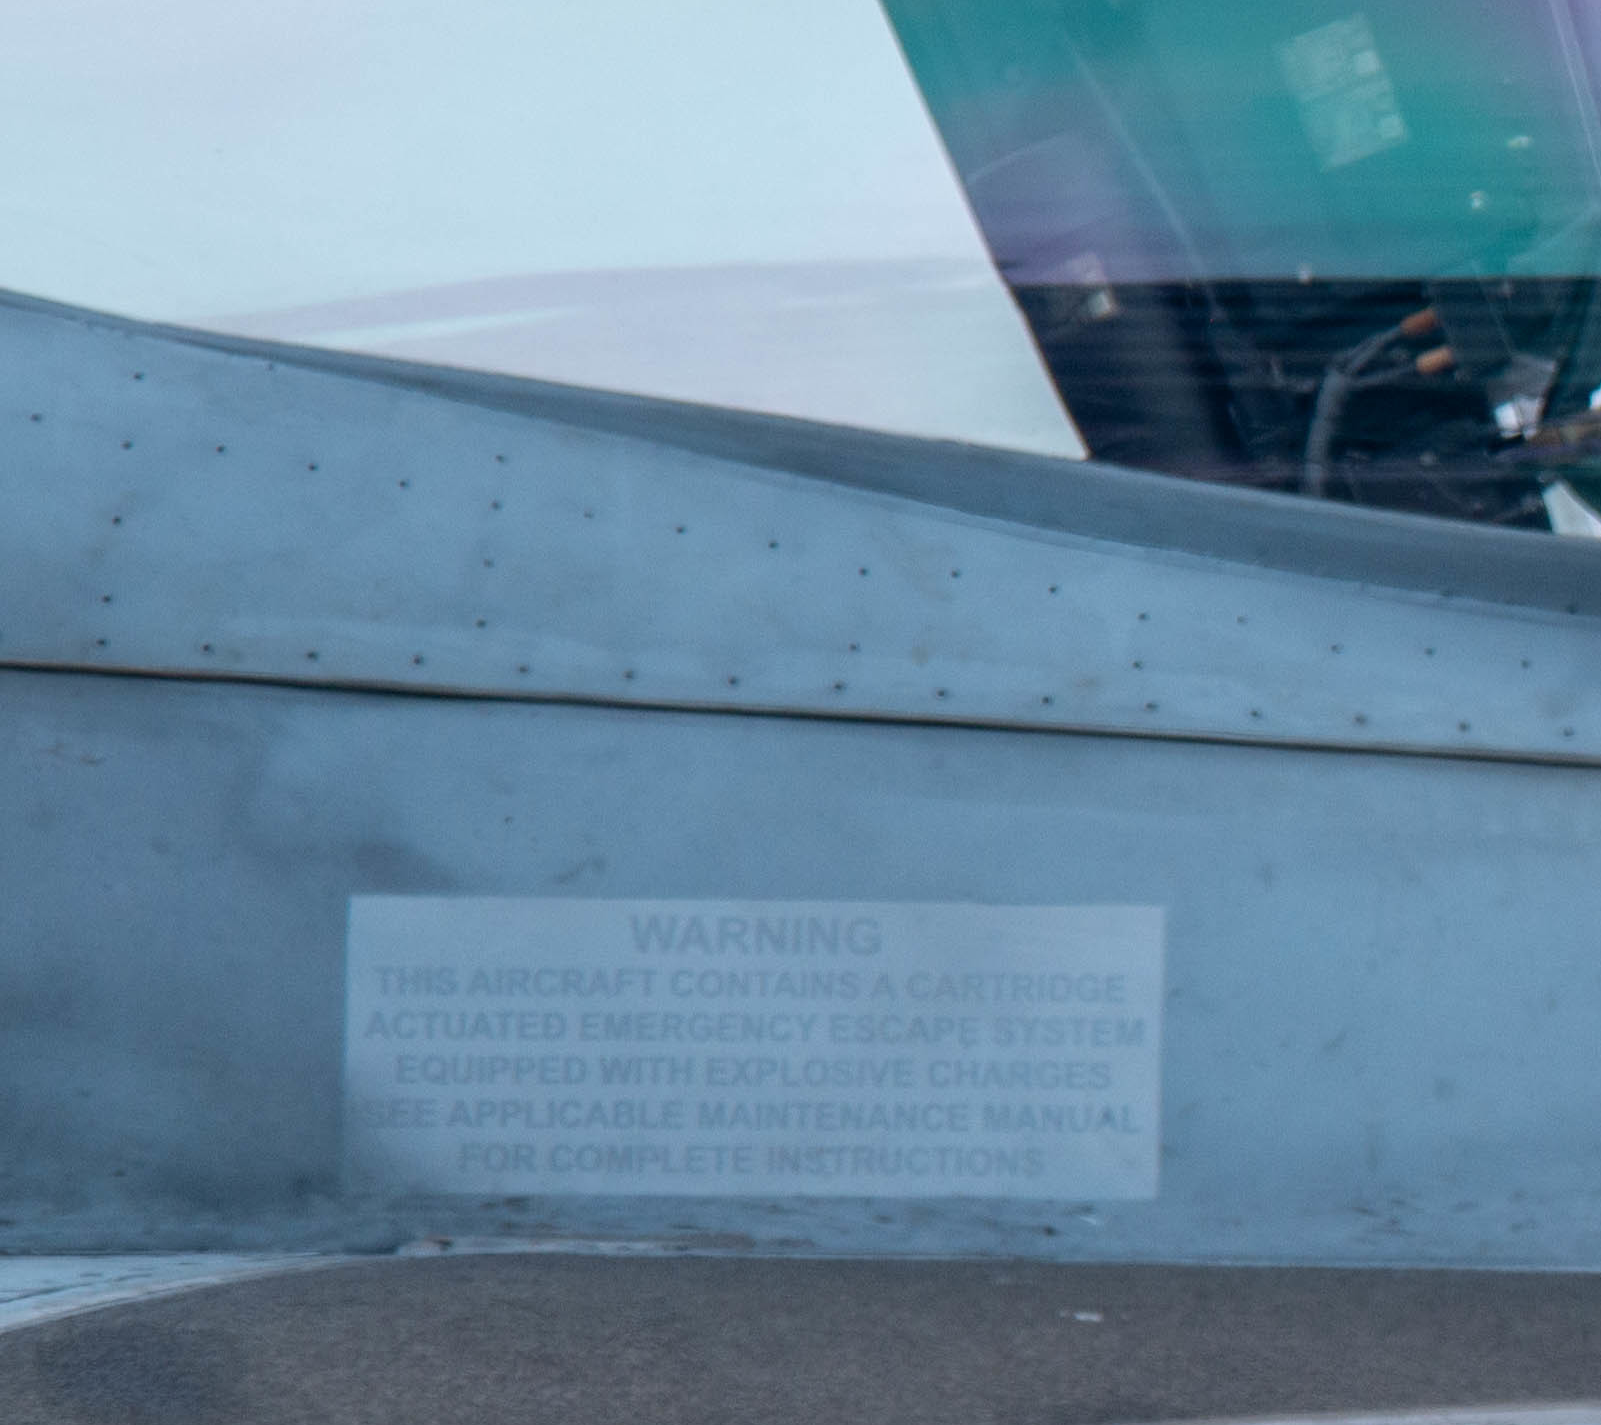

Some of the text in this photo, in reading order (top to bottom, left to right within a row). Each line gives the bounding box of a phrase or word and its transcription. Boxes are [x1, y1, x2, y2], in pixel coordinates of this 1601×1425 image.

[629, 914, 882, 957] WARNING
[374, 966, 1127, 1005] THIS AIRCRAFT CONTAINS A CARTRIDGE
[363, 1010, 1145, 1049] ACTUATED EMERGENCY ESCAPE SYSTEM
[396, 1054, 1112, 1092] EQUIPPED WITH EXPLOSIVE CHARGES
[448, 1099, 683, 1132] APPLICABLE
[696, 1100, 970, 1134] MAINTENANCE
[982, 1102, 1141, 1136] MANUAL
[458, 1143, 1046, 1179] FOR COMPLETE INSTRUCTIONS
